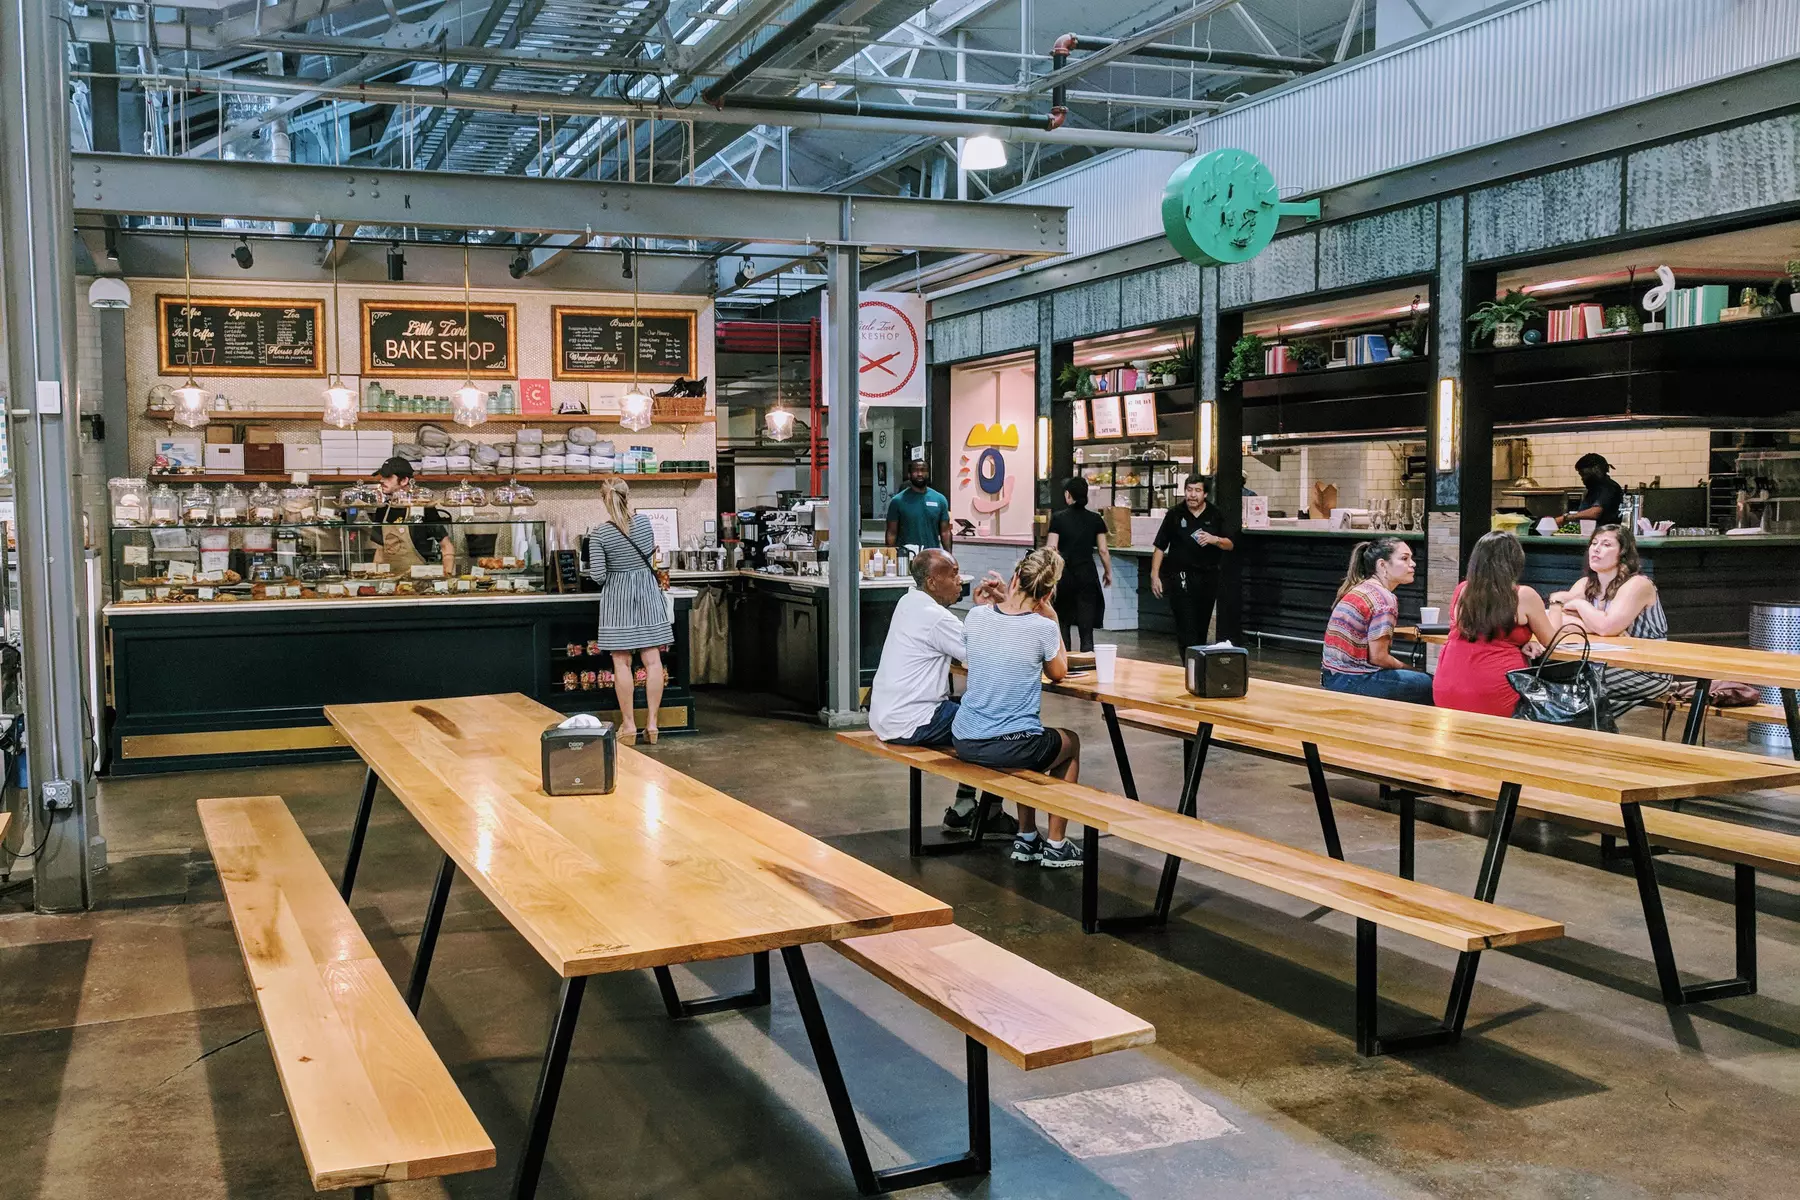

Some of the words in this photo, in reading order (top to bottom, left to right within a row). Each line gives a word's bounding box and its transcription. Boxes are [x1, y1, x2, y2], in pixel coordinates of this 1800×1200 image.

[405, 195, 411, 209] K
[228, 308, 261, 320] Espresso
[283, 308, 300, 318] Tea
[192, 328, 214, 341] Coffee
[402, 320, 435, 337] Little
[438, 319, 468, 337] Tart
[386, 339, 437, 359] BAKE
[440, 341, 495, 360] SHOP
